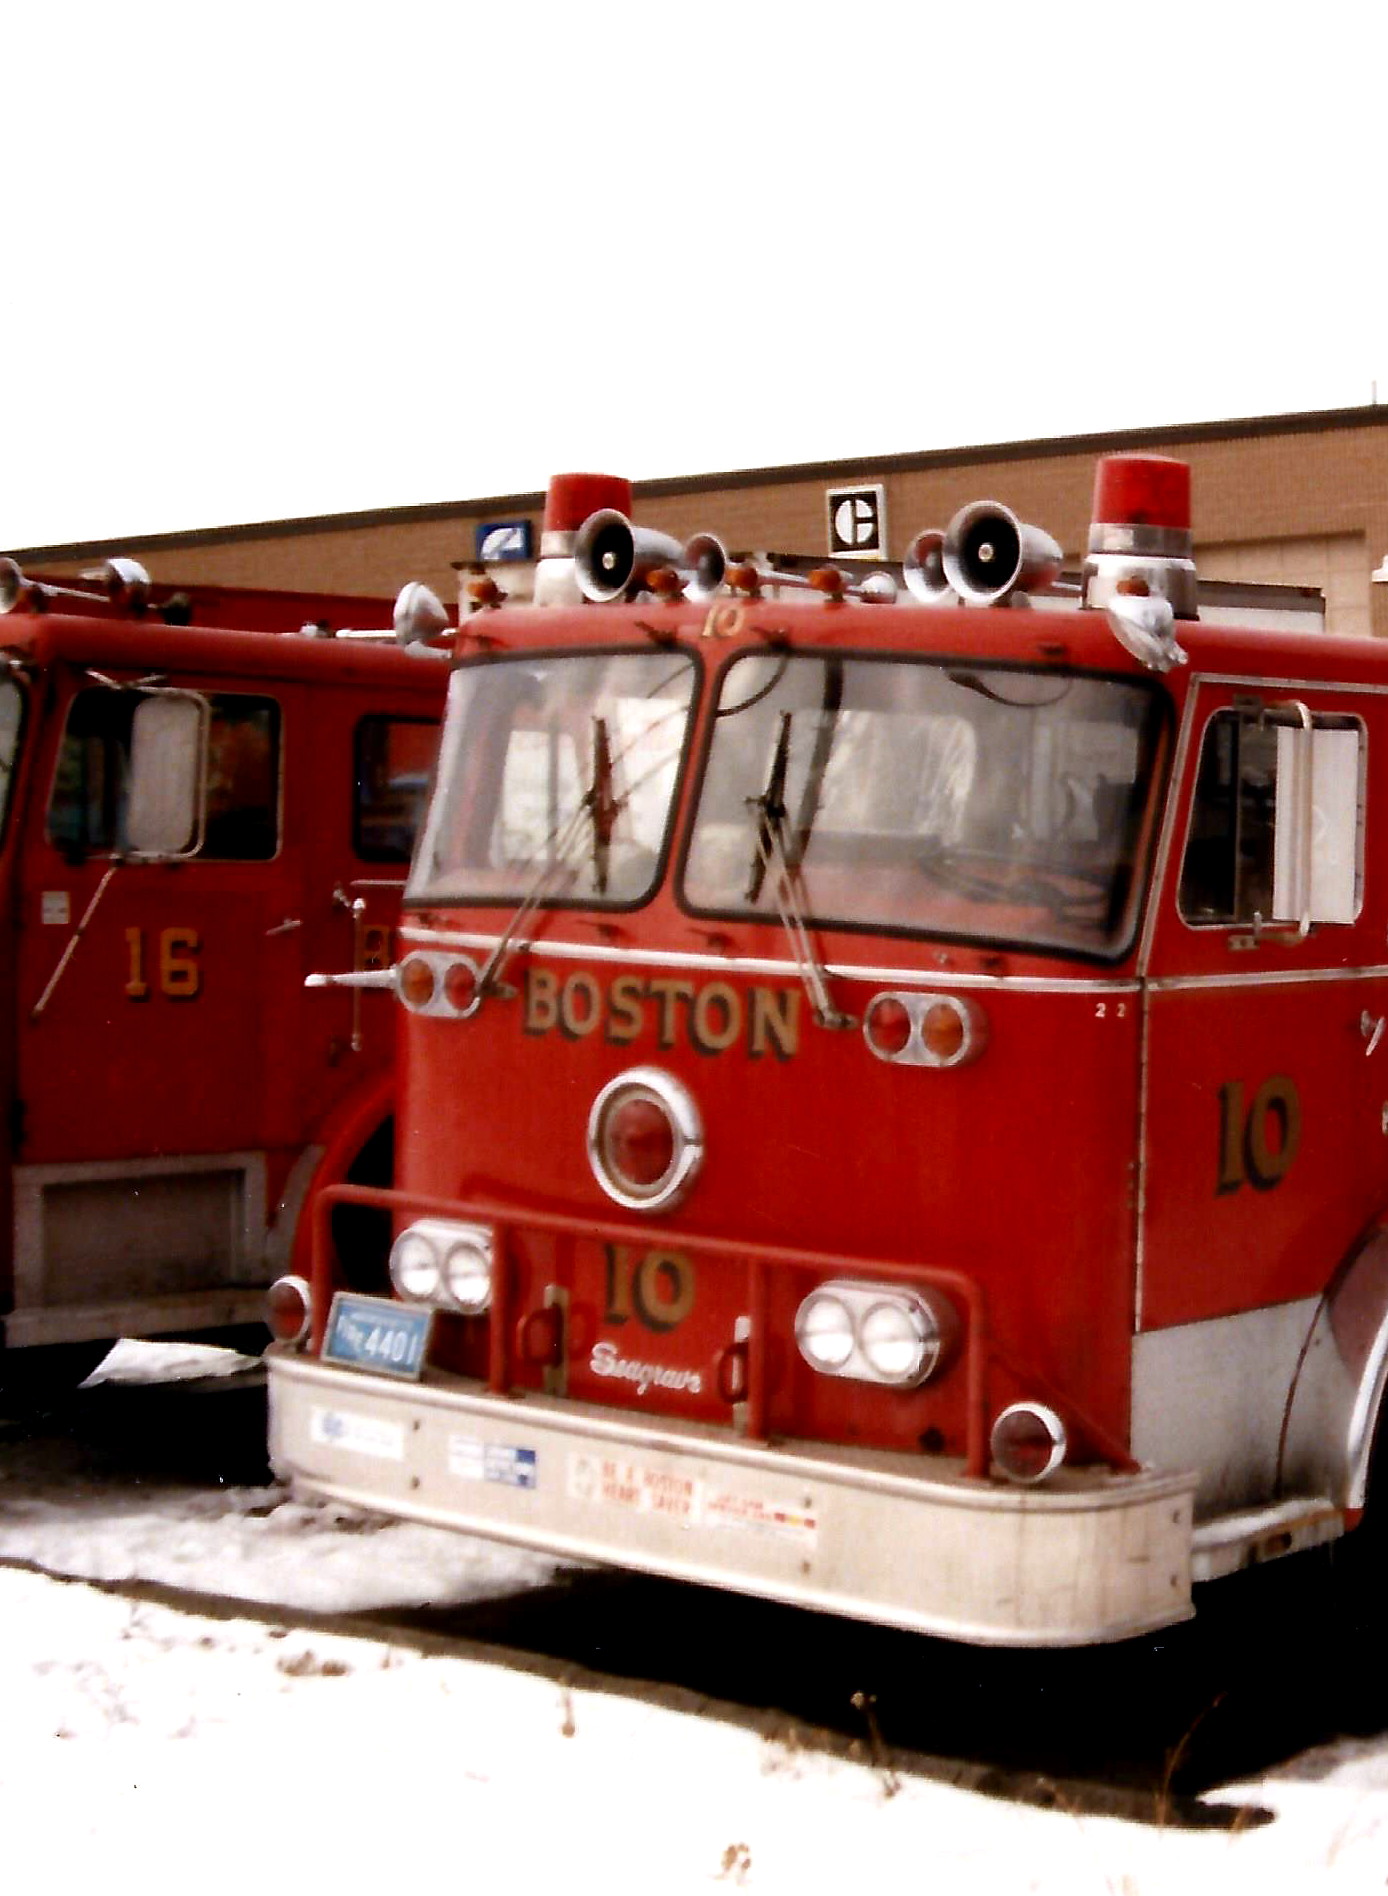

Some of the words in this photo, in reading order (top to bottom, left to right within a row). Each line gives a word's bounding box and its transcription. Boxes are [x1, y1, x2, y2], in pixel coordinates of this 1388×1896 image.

[702, 603, 745, 639] 10
[125, 926, 204, 1003] 16
[524, 968, 800, 1061] BOSTON
[1214, 1075, 1302, 1197] 10
[604, 1244, 695, 1332] 10
